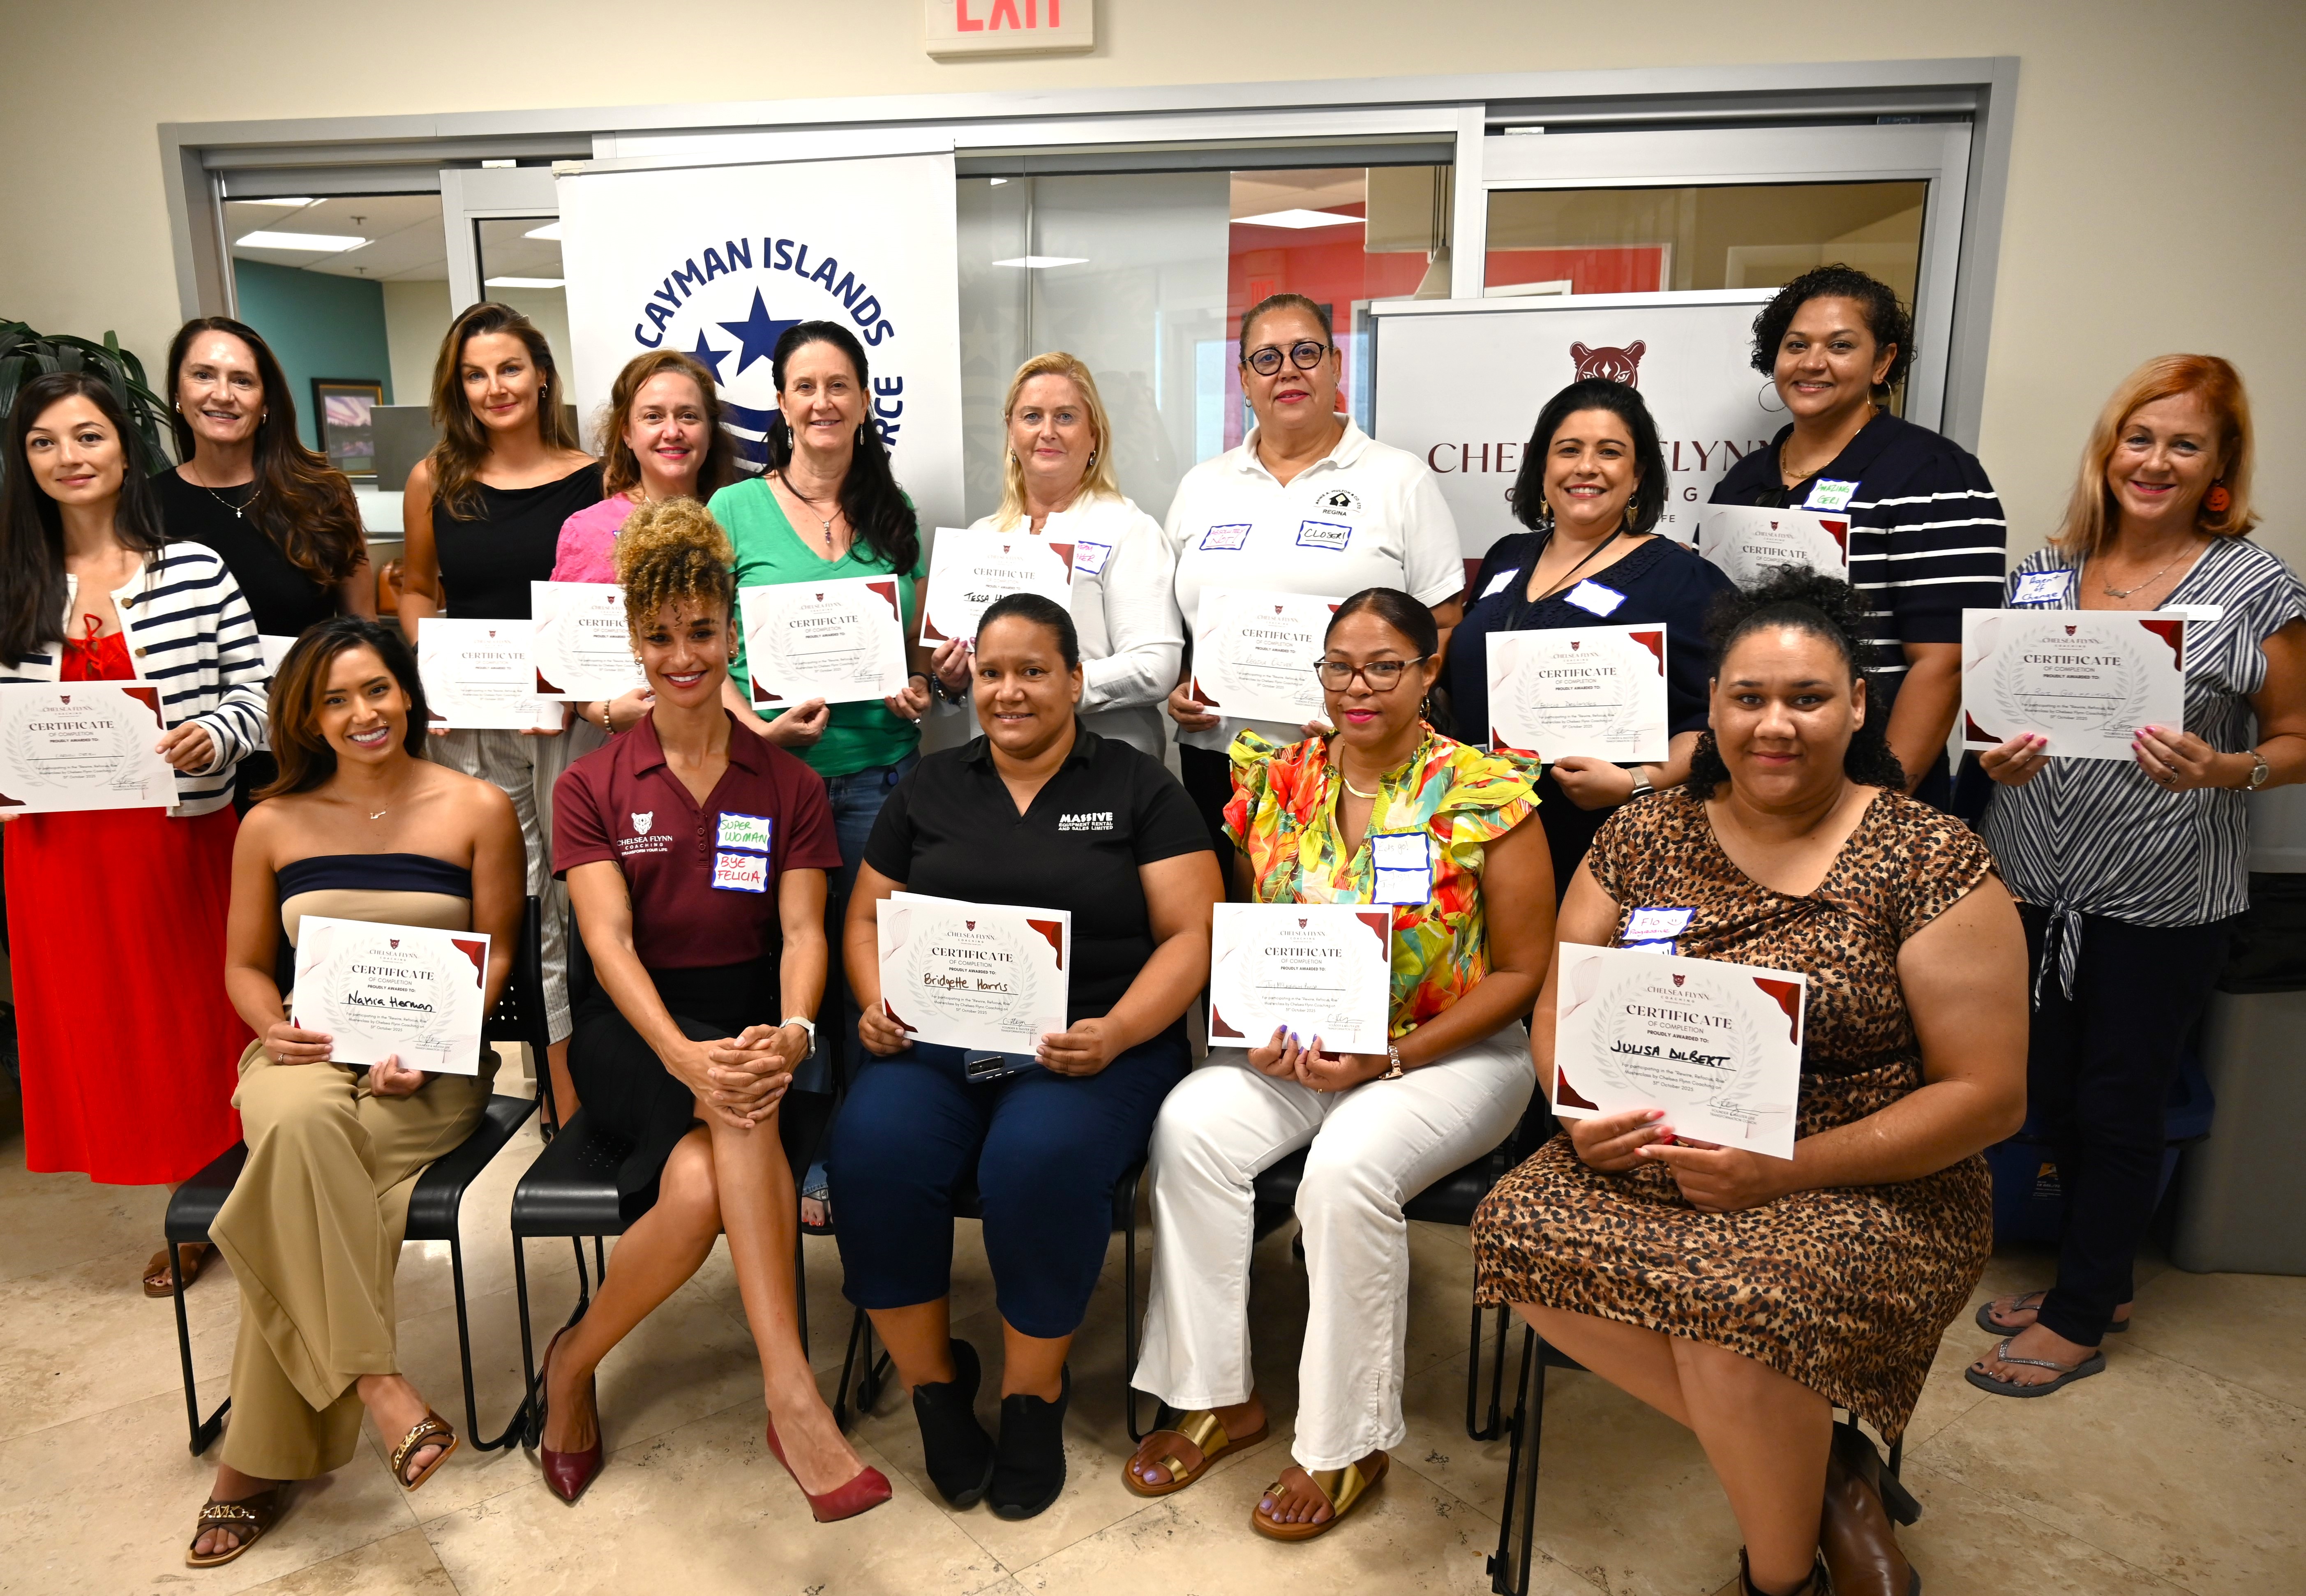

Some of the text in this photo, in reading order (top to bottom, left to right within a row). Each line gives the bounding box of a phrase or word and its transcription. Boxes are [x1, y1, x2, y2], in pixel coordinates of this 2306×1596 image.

[635, 237, 895, 348] CAYMAN ISLANDS
[1815, 484, 1850, 494] AMAZING
[1817, 495, 1840, 505] GERI
[1210, 534, 1240, 545] NOT!
[1304, 528, 1345, 542] CLOSER!
[1743, 545, 1807, 559] CERTIFICATE
[974, 567, 1035, 579] CERTIFICATE
[2029, 574, 2061, 587] Agent
[2034, 584, 2045, 592] of
[964, 592, 990, 602] TESSA
[790, 616, 857, 627] CERTIFICATE
[1242, 630, 1311, 642] CERTIFICATE
[2024, 655, 2120, 665] CERTIFICATE
[1539, 668, 1615, 678] CERTIFICATE
[30, 721, 113, 730] CERTIFICATE
[1060, 812, 1113, 823] MASSIVE
[720, 819, 751, 830] SUPER
[616, 836, 648, 846] CHELSEA
[725, 831, 767, 844] WOMAN
[1398, 841, 1409, 855] go!
[720, 856, 746, 869] BYE
[717, 870, 761, 883] FELICIA
[1641, 918, 1660, 926] Flo
[932, 948, 1012, 962] CERTIFICATE
[1265, 948, 1341, 957] CERTIFICATE
[352, 965, 433, 980] CERTIFICATE
[924, 973, 1008, 992] Bridgette Harris
[1647, 987, 1682, 996] CHELSEA
[348, 990, 433, 1012] Nakia Herman
[1627, 1005, 1731, 1028] CERTIFICATE
[1660, 1022, 1703, 1033] COMPLETION
[1610, 1040, 1731, 1067] JULISA DILBERT
[1692, 1081, 1714, 1089] Coaching
